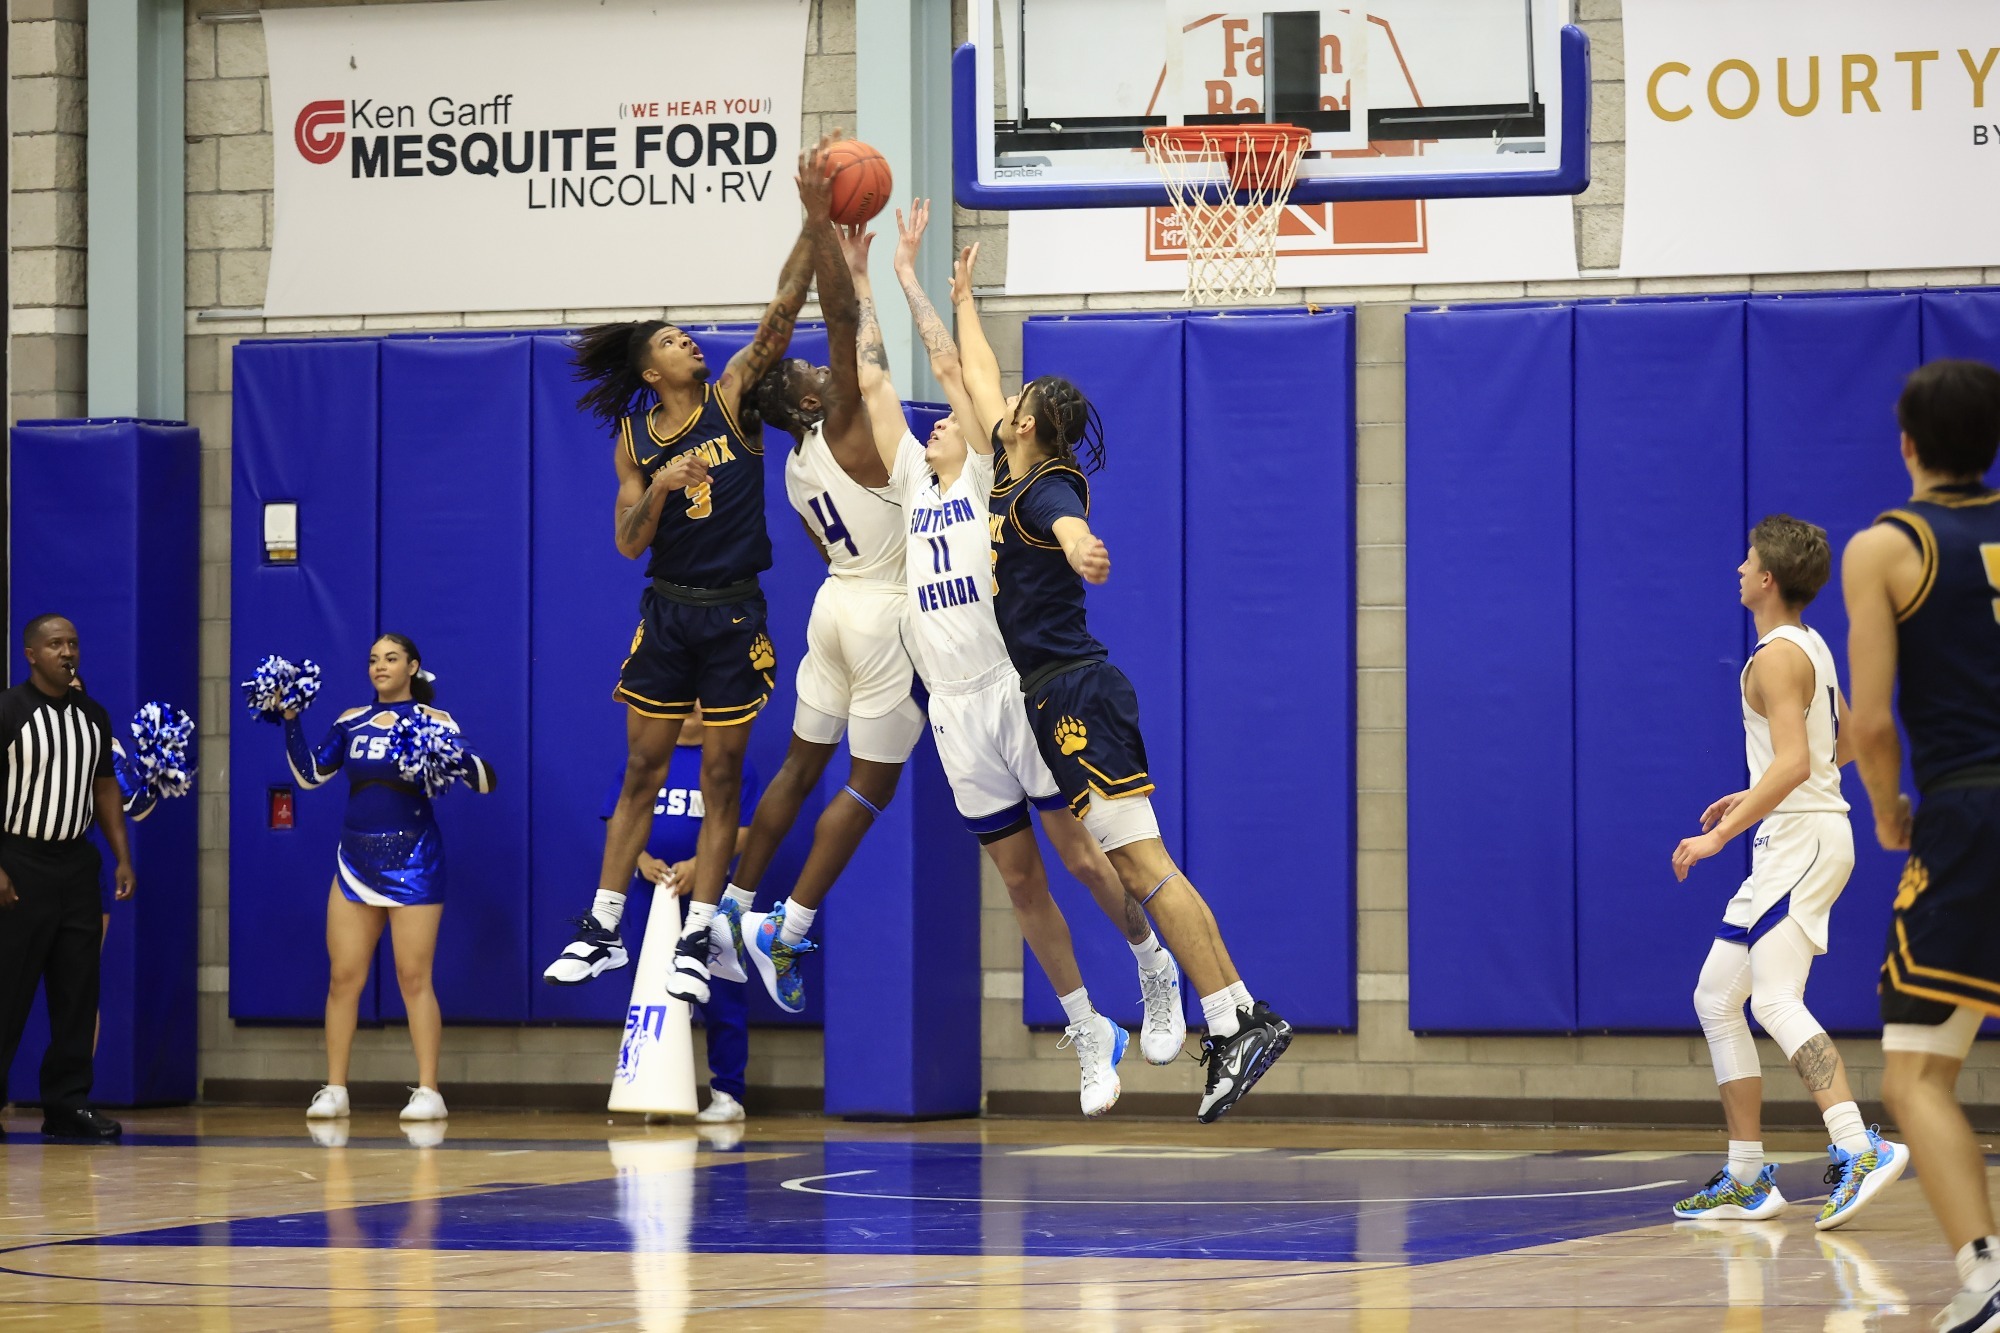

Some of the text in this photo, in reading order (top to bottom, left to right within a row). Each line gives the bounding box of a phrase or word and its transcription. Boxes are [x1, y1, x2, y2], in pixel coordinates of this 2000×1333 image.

[1647, 47, 2000, 122] COURTY
[351, 94, 513, 128] Ken Garff
[667, 100, 716, 116] HEAR
[351, 121, 777, 178] MESQUITE FORD
[528, 170, 772, 209] LINCOLN RV
[1161, 229, 1198, 247] 197
[684, 481, 713, 520] 3
[807, 490, 860, 557] 4
[927, 534, 952, 575] 11
[917, 575, 981, 613] NEVADA
[350, 734, 391, 760] CS
